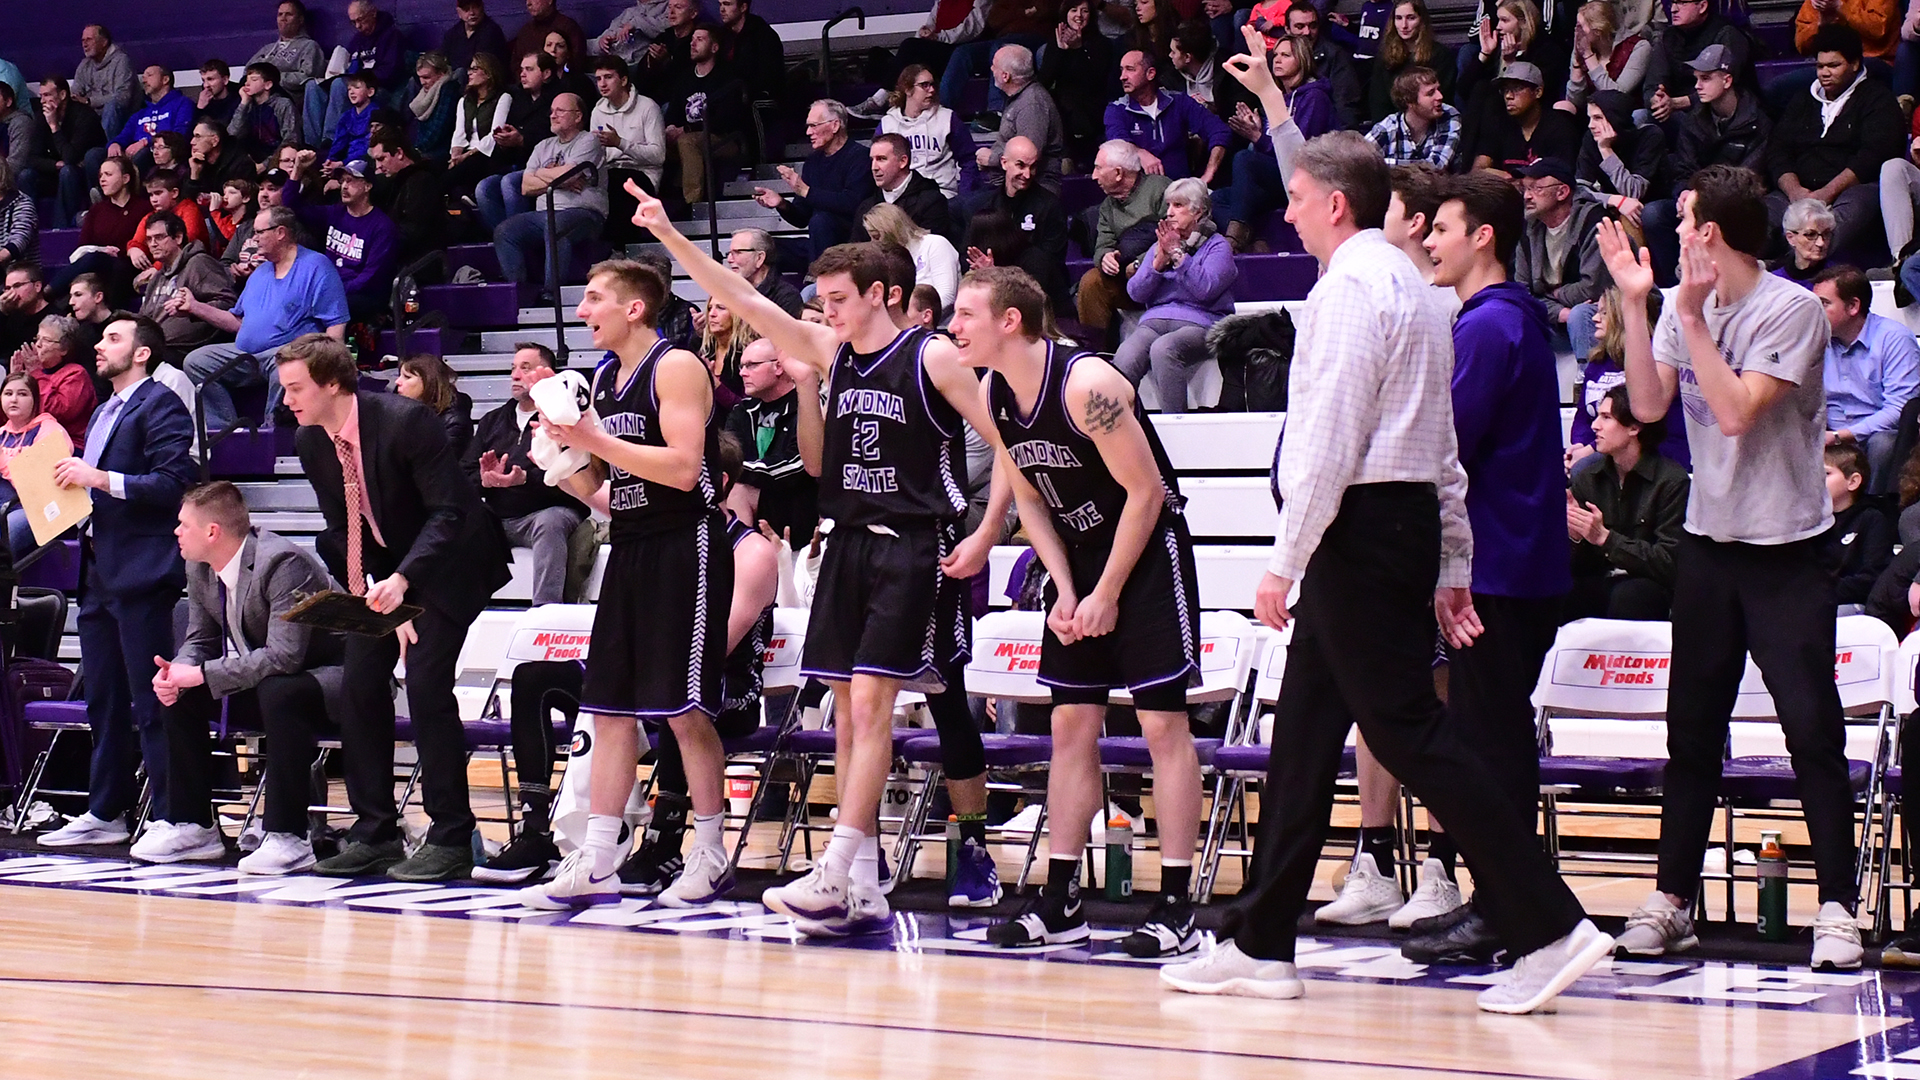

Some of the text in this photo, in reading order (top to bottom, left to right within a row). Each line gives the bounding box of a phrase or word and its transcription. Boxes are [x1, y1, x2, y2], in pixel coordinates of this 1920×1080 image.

[843, 464, 899, 493] SATE
[544, 646, 582, 661] Foods
[993, 643, 1042, 658] Midto
[1007, 657, 1041, 671] Foo
[1583, 654, 1670, 670] Midtown
[1600, 670, 1654, 686] Foods
